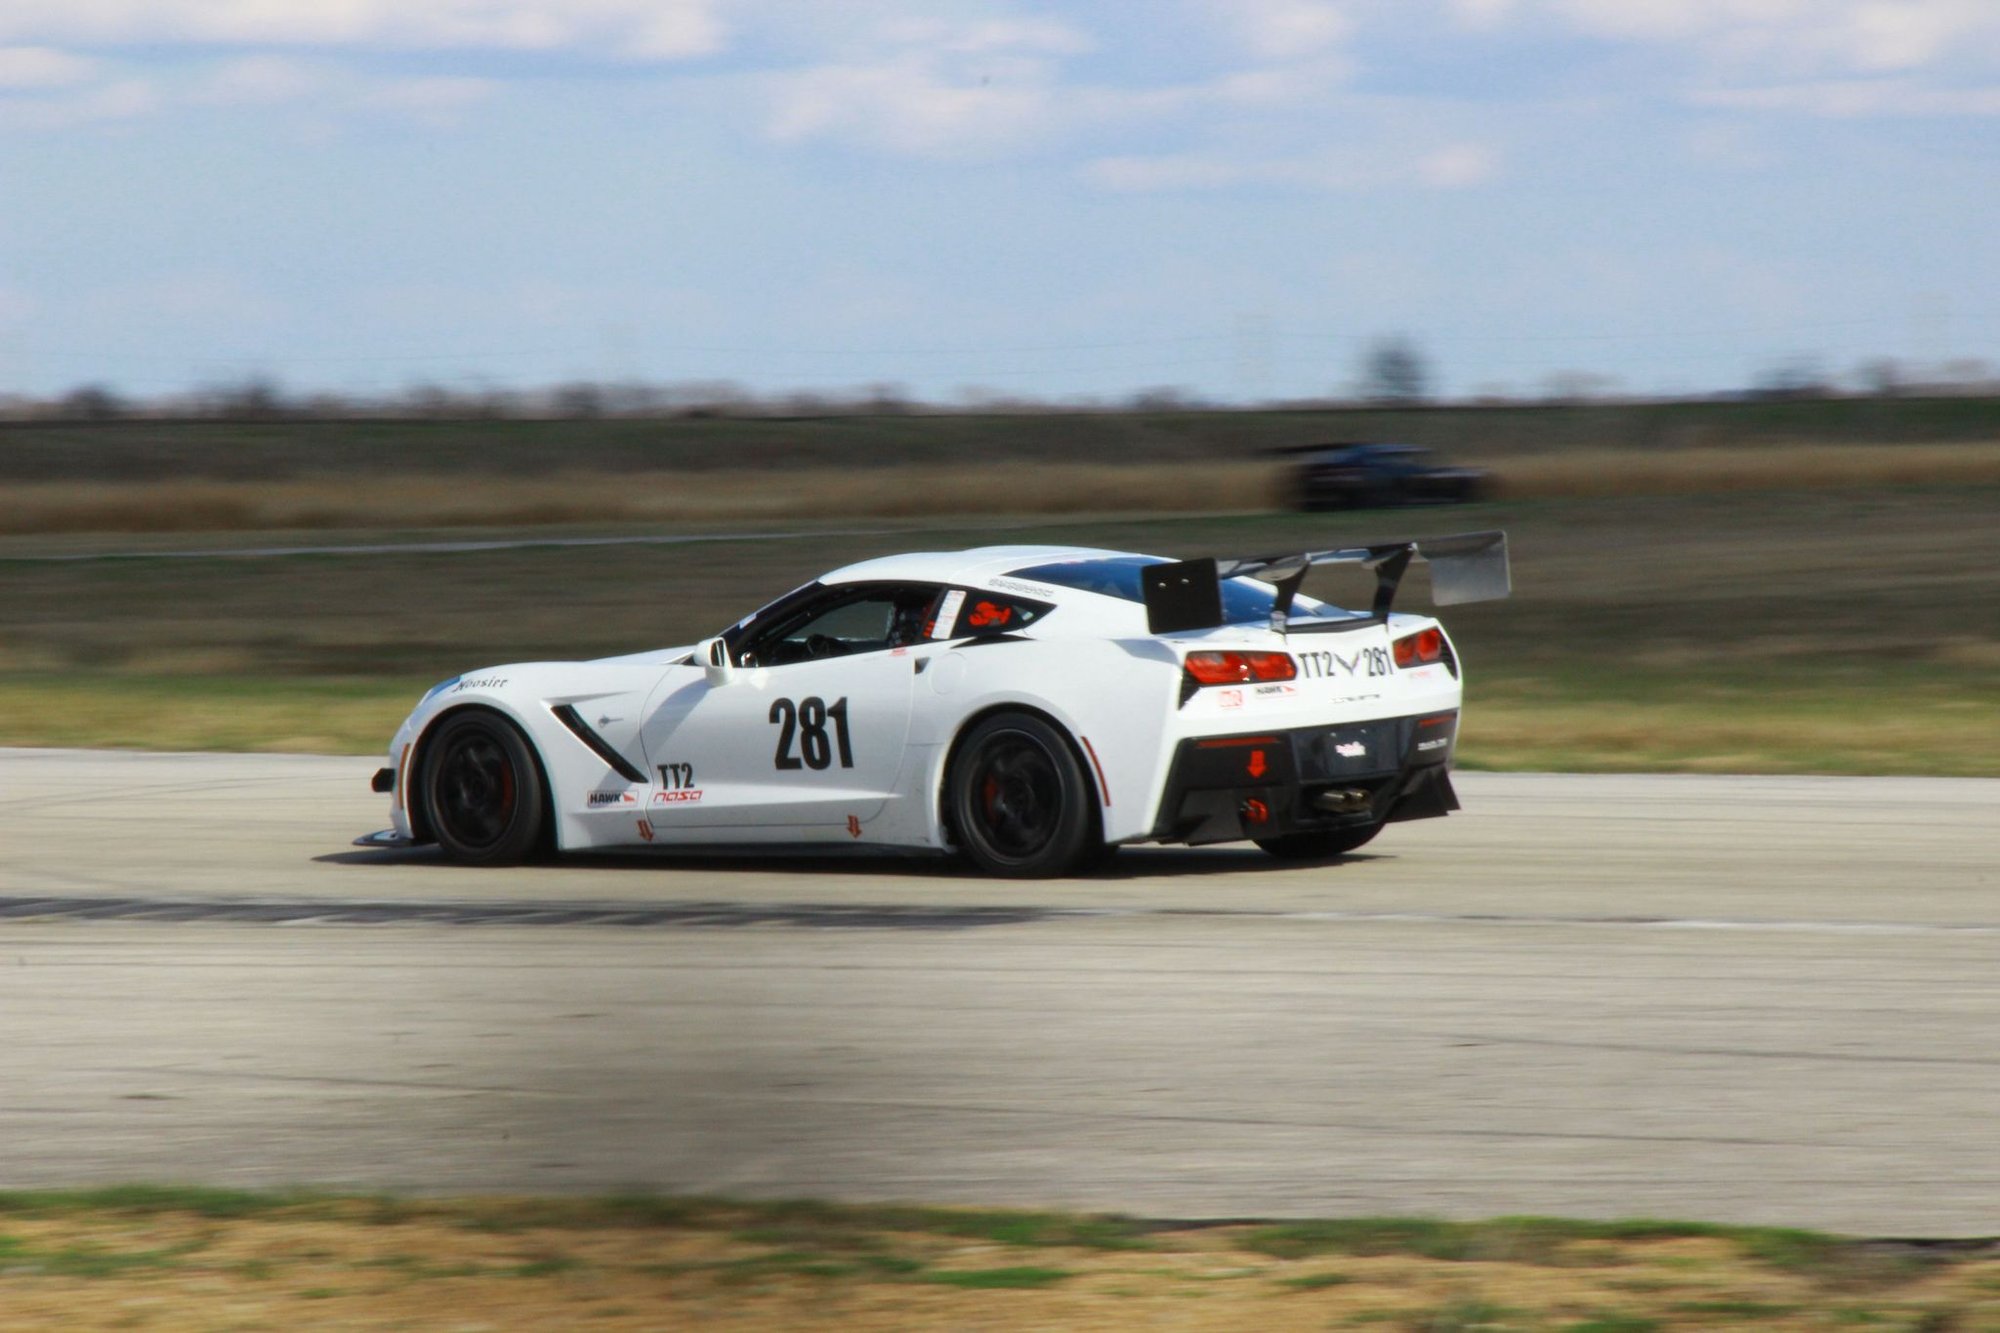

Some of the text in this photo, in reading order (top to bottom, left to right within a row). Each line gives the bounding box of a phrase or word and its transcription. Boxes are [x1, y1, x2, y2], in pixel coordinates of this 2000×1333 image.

[1298, 646, 1393, 678] TT2 281
[769, 696, 854, 770] 281
[657, 762, 695, 790] TT2
[589, 793, 621, 804] HAWK
